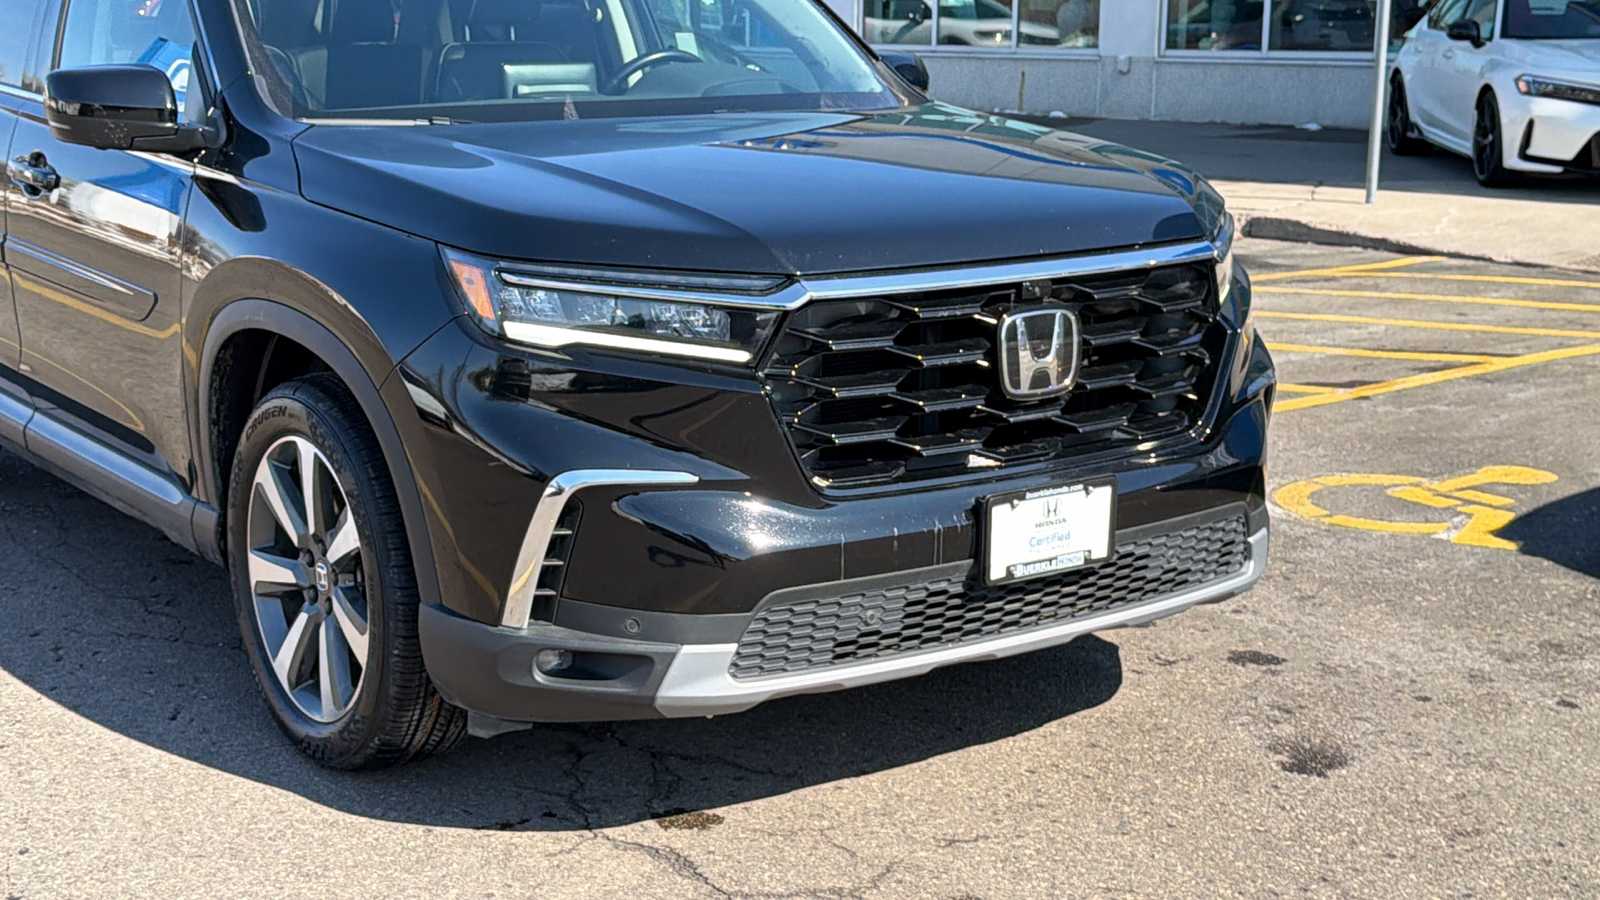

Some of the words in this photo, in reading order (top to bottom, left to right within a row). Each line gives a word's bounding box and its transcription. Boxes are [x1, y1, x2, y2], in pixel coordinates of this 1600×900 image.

[246, 405, 288, 441] CRUGEN
[1035, 517, 1067, 528] HONDA
[1029, 530, 1071, 547] Certified
[1016, 559, 1058, 577] BUERKLE
[1058, 554, 1082, 566] HONDA
